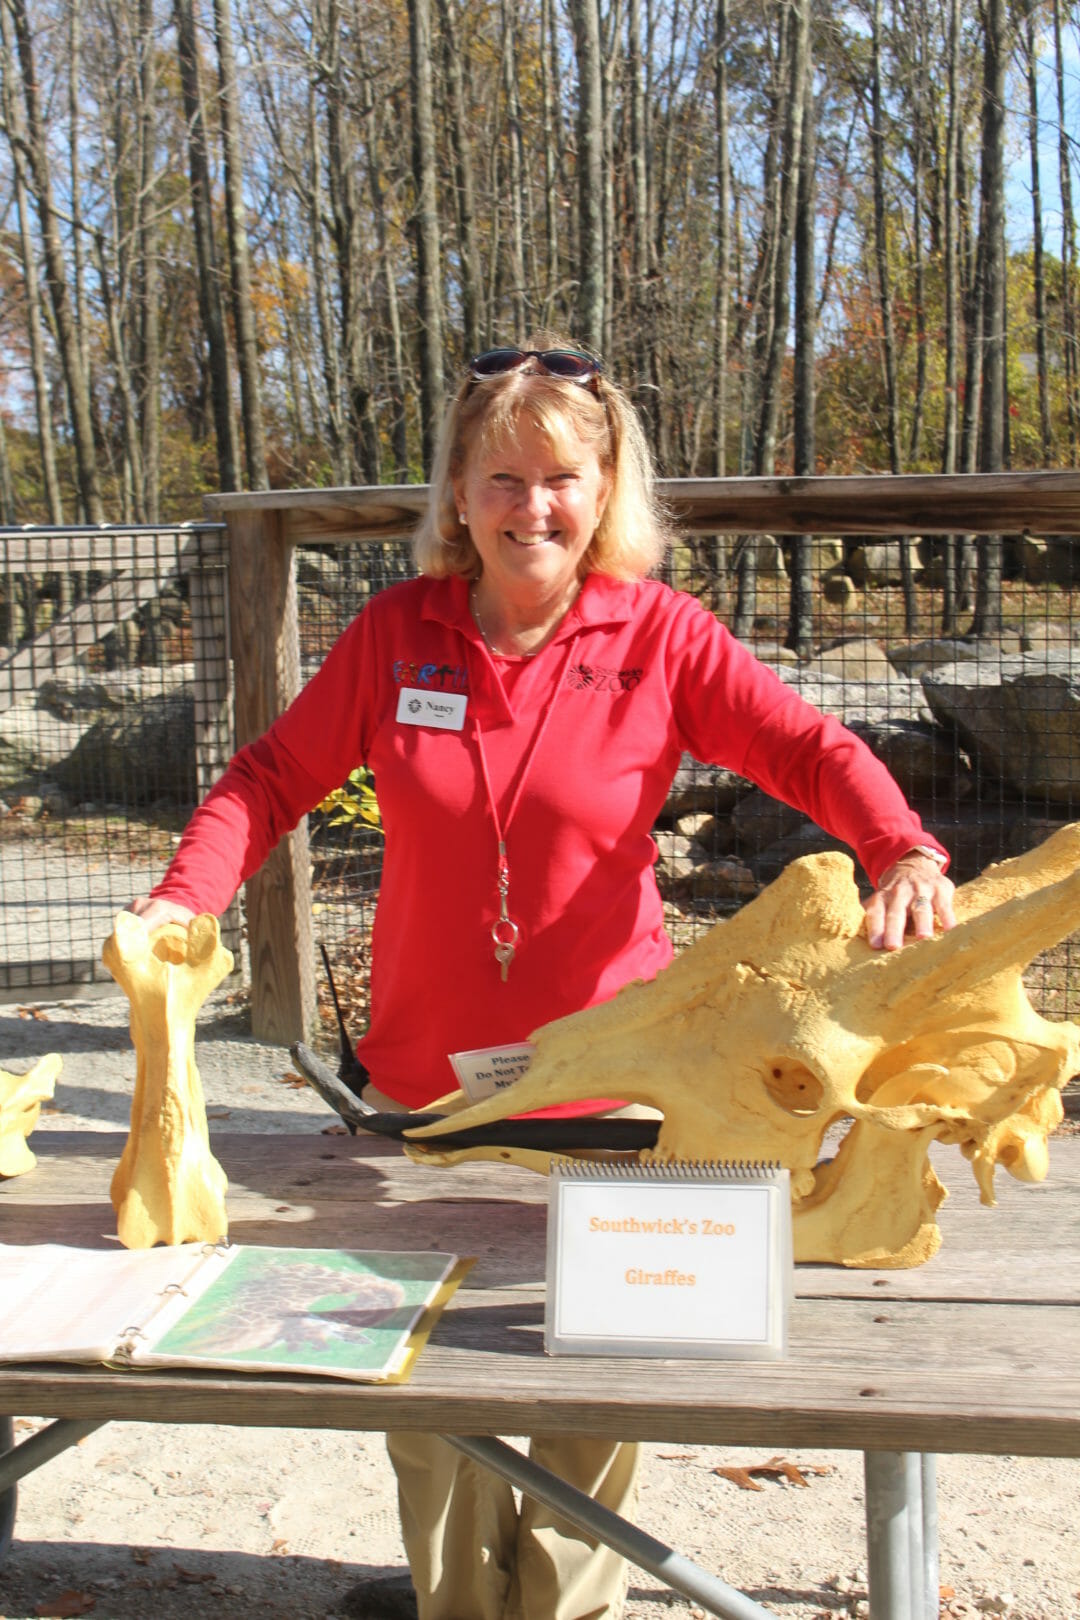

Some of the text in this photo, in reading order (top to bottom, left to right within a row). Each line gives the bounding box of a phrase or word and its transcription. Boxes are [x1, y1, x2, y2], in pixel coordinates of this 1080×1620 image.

[595, 675, 640, 692] ZOO
[426, 701, 455, 715] Nancy
[491, 1055, 529, 1065] Please
[475, 1072, 492, 1080] Do
[495, 1068, 516, 1077] Not
[589, 1217, 736, 1236] Southwick's Zoo
[625, 1269, 697, 1286] Giraffes
